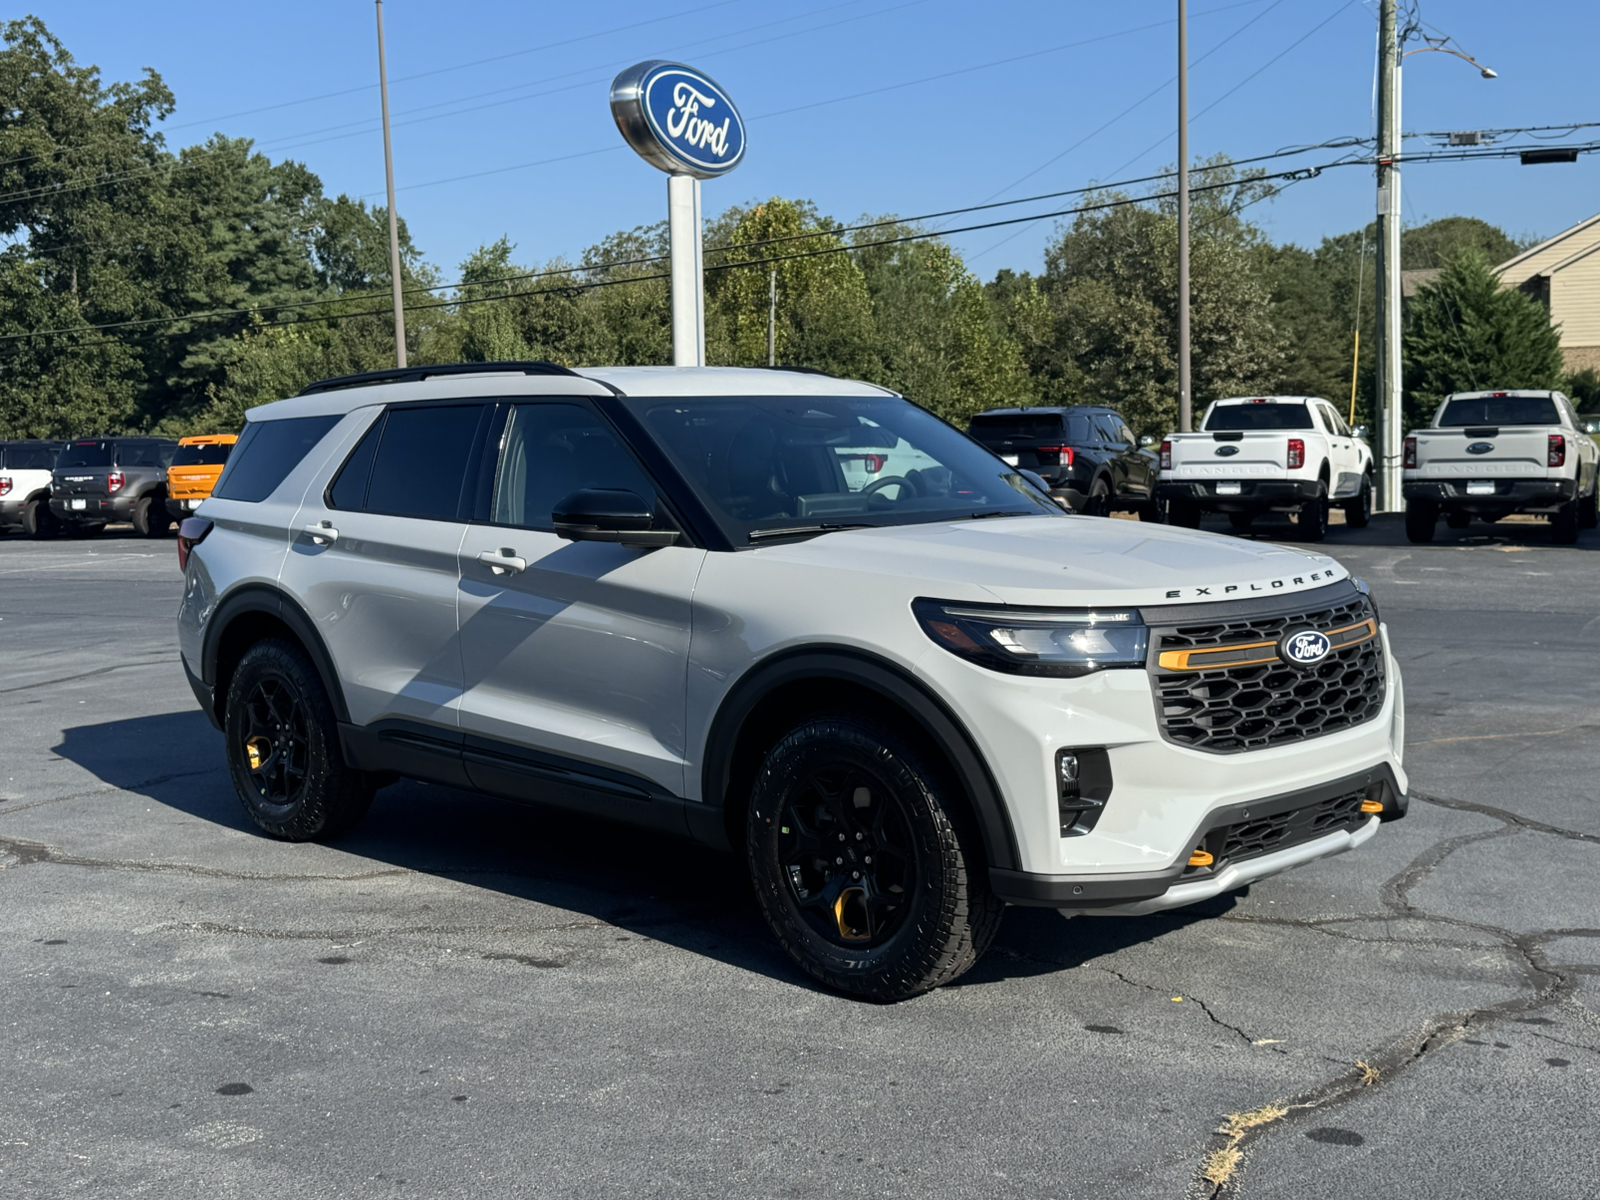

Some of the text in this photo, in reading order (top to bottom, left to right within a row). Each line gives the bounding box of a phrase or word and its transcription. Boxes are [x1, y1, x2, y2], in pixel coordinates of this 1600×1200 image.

[667, 82, 730, 157] Ford
[1165, 569, 1334, 599] EXPLORER
[1295, 635, 1324, 658] Ford
